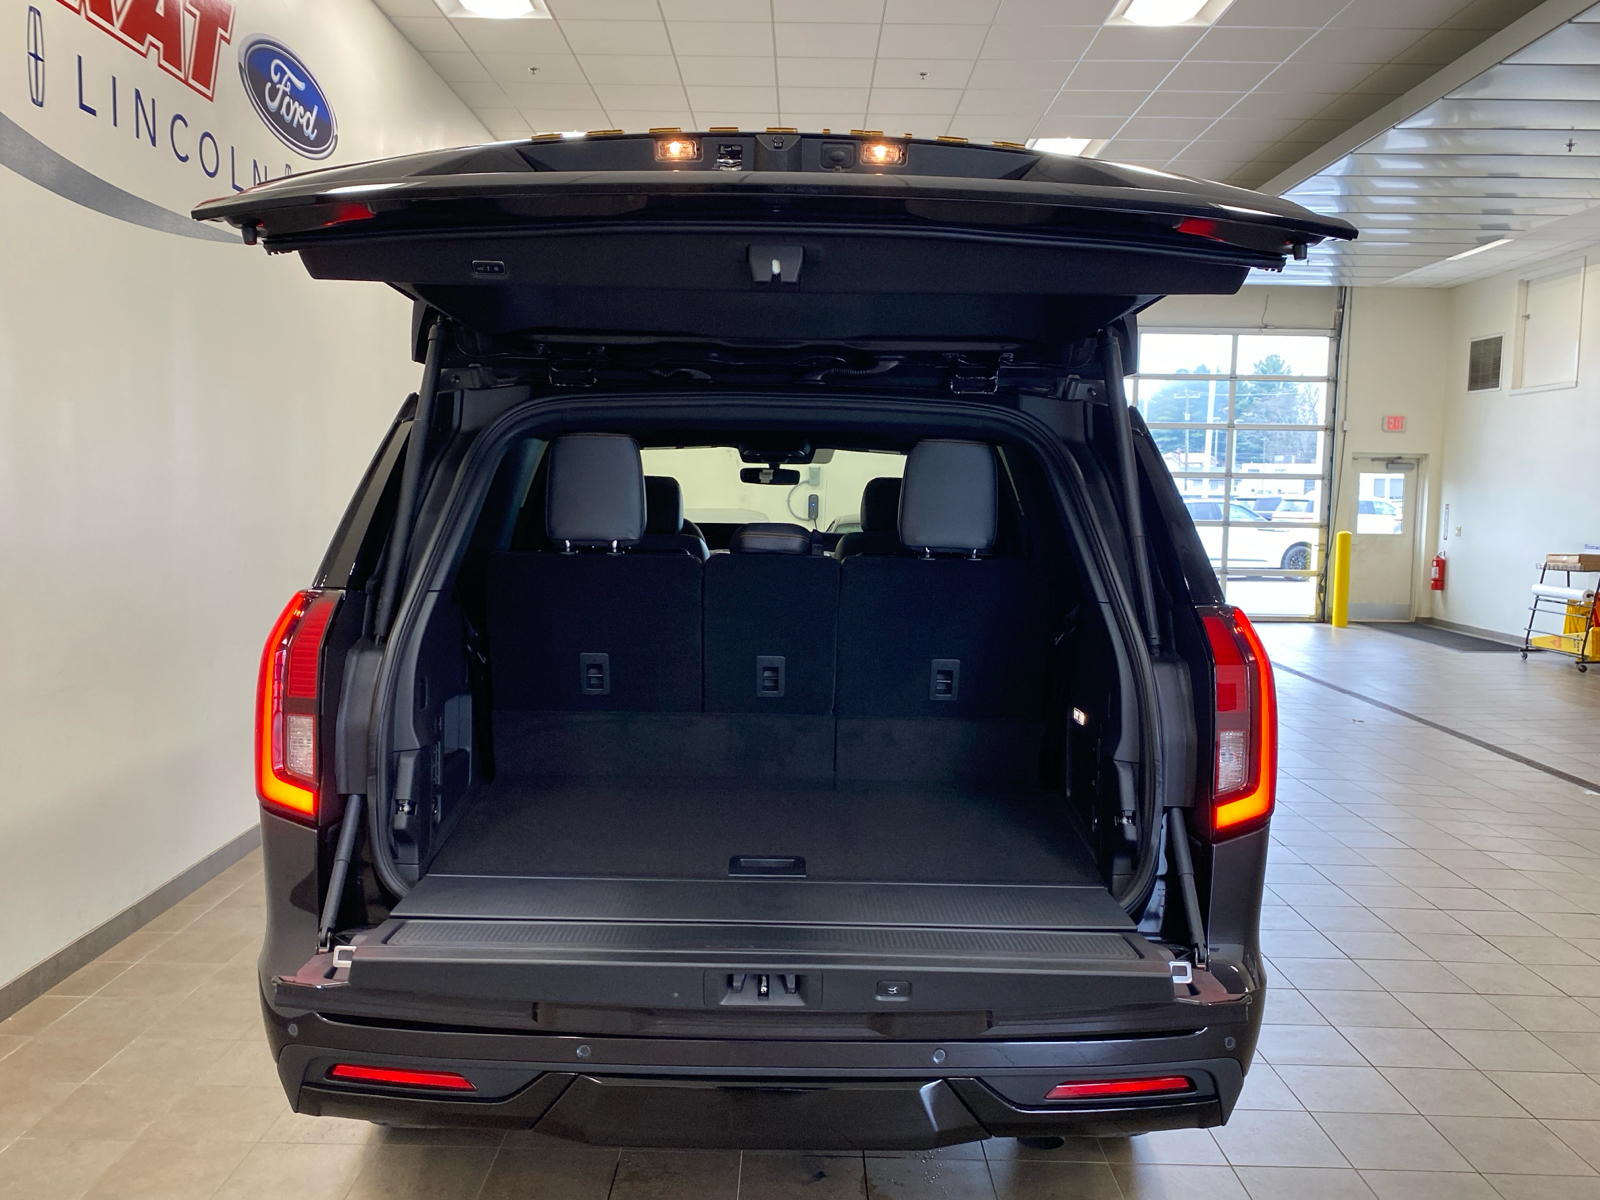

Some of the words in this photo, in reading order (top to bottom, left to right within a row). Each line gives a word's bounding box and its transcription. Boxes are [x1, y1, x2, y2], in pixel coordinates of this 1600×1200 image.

[76, 54, 268, 192] LINCOLN
[264, 58, 319, 142] Ford
[1386, 415, 1405, 430] EXIT
